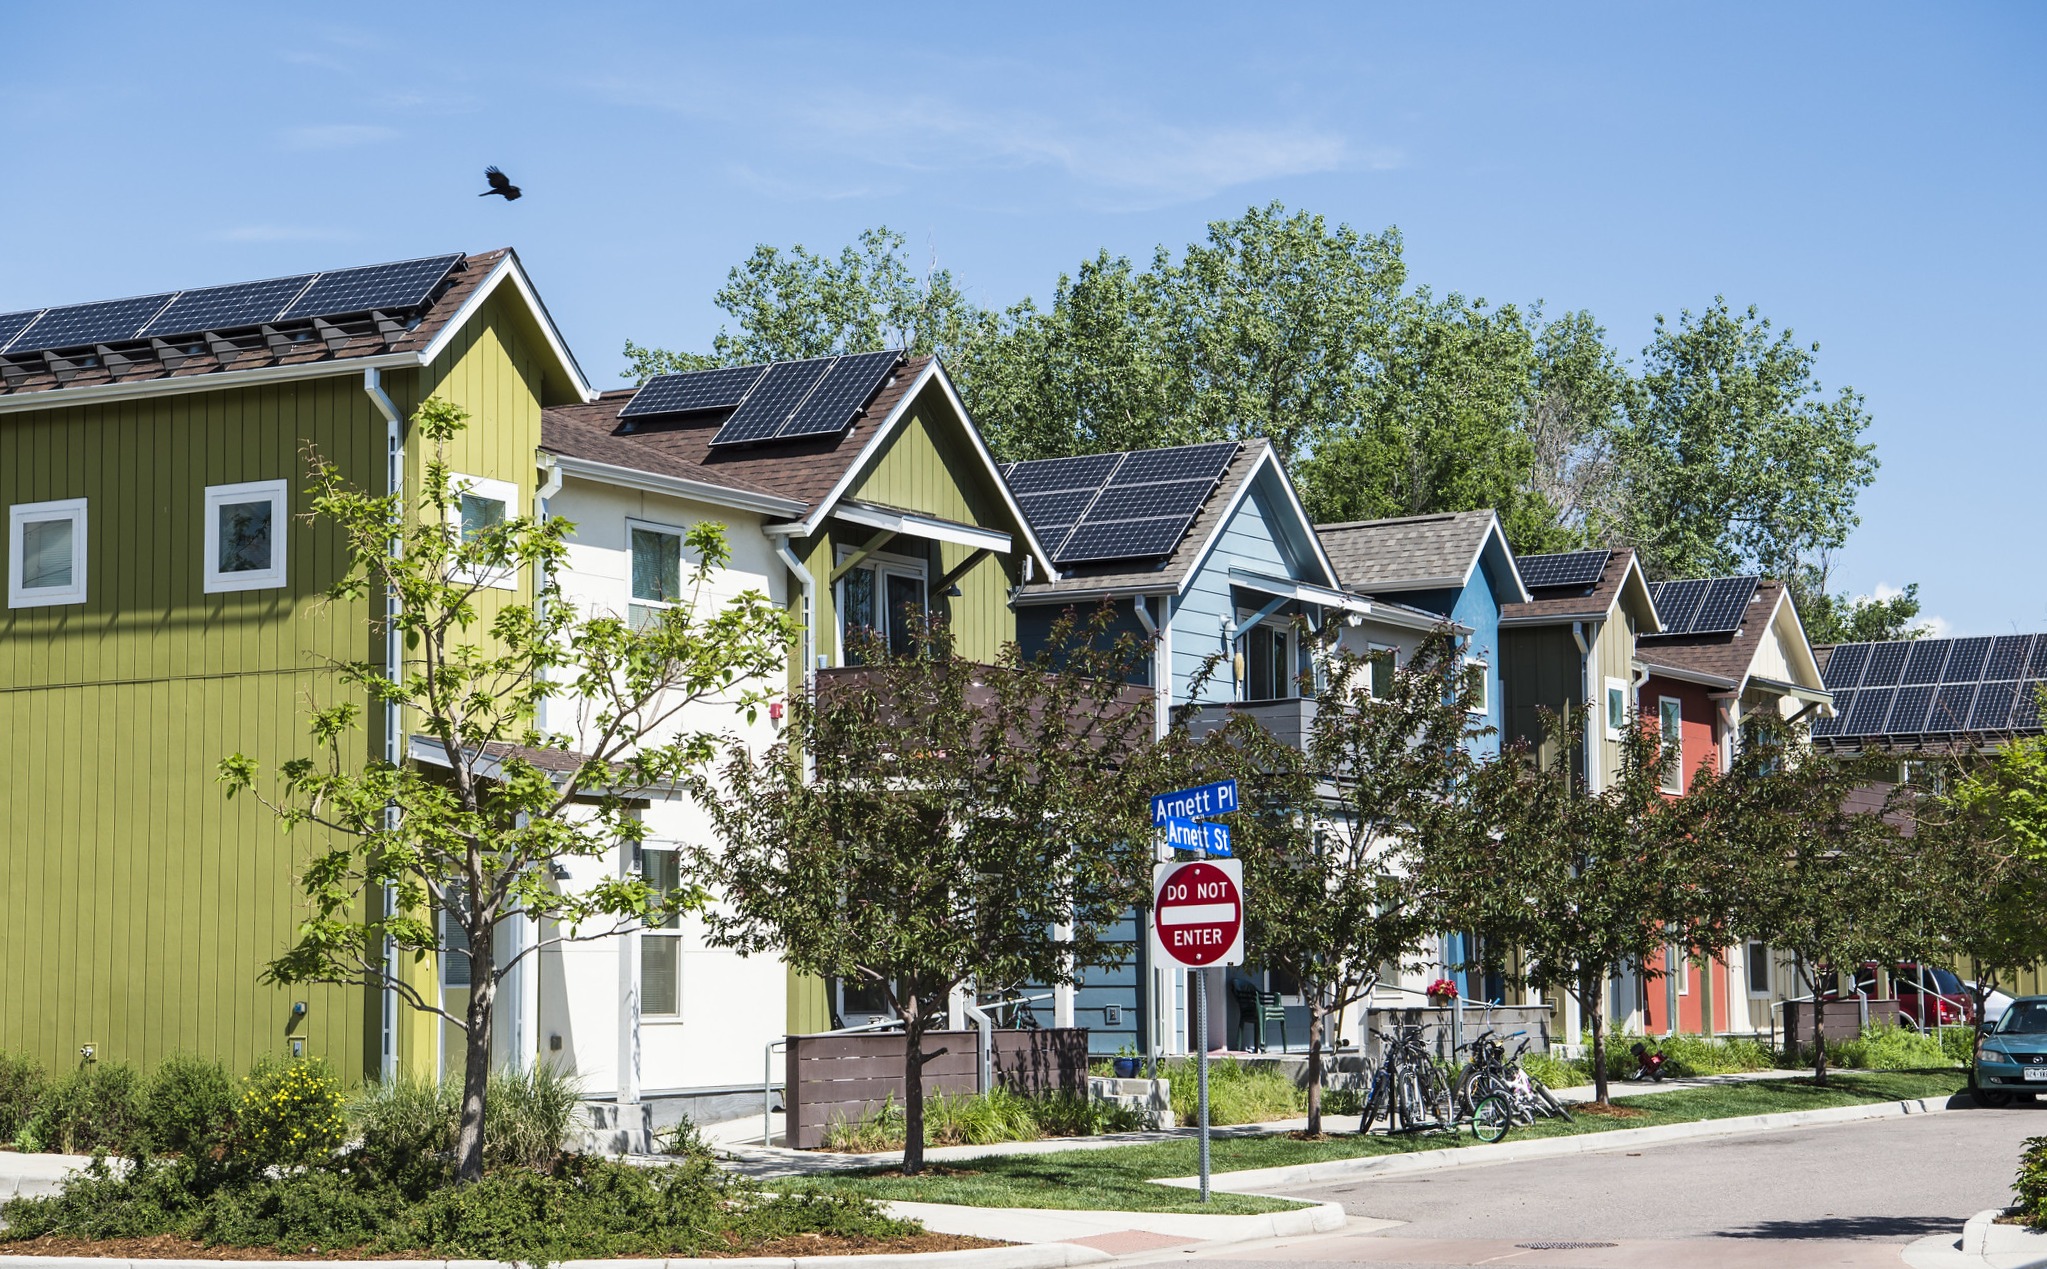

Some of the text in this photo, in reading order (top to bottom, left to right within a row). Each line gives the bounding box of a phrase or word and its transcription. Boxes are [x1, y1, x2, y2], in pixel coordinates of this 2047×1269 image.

[1156, 785, 1234, 822] Arnett Pl
[1169, 820, 1229, 851] Arnett St
[1167, 881, 1228, 901] DO NOT
[1174, 928, 1222, 946] ENTER
